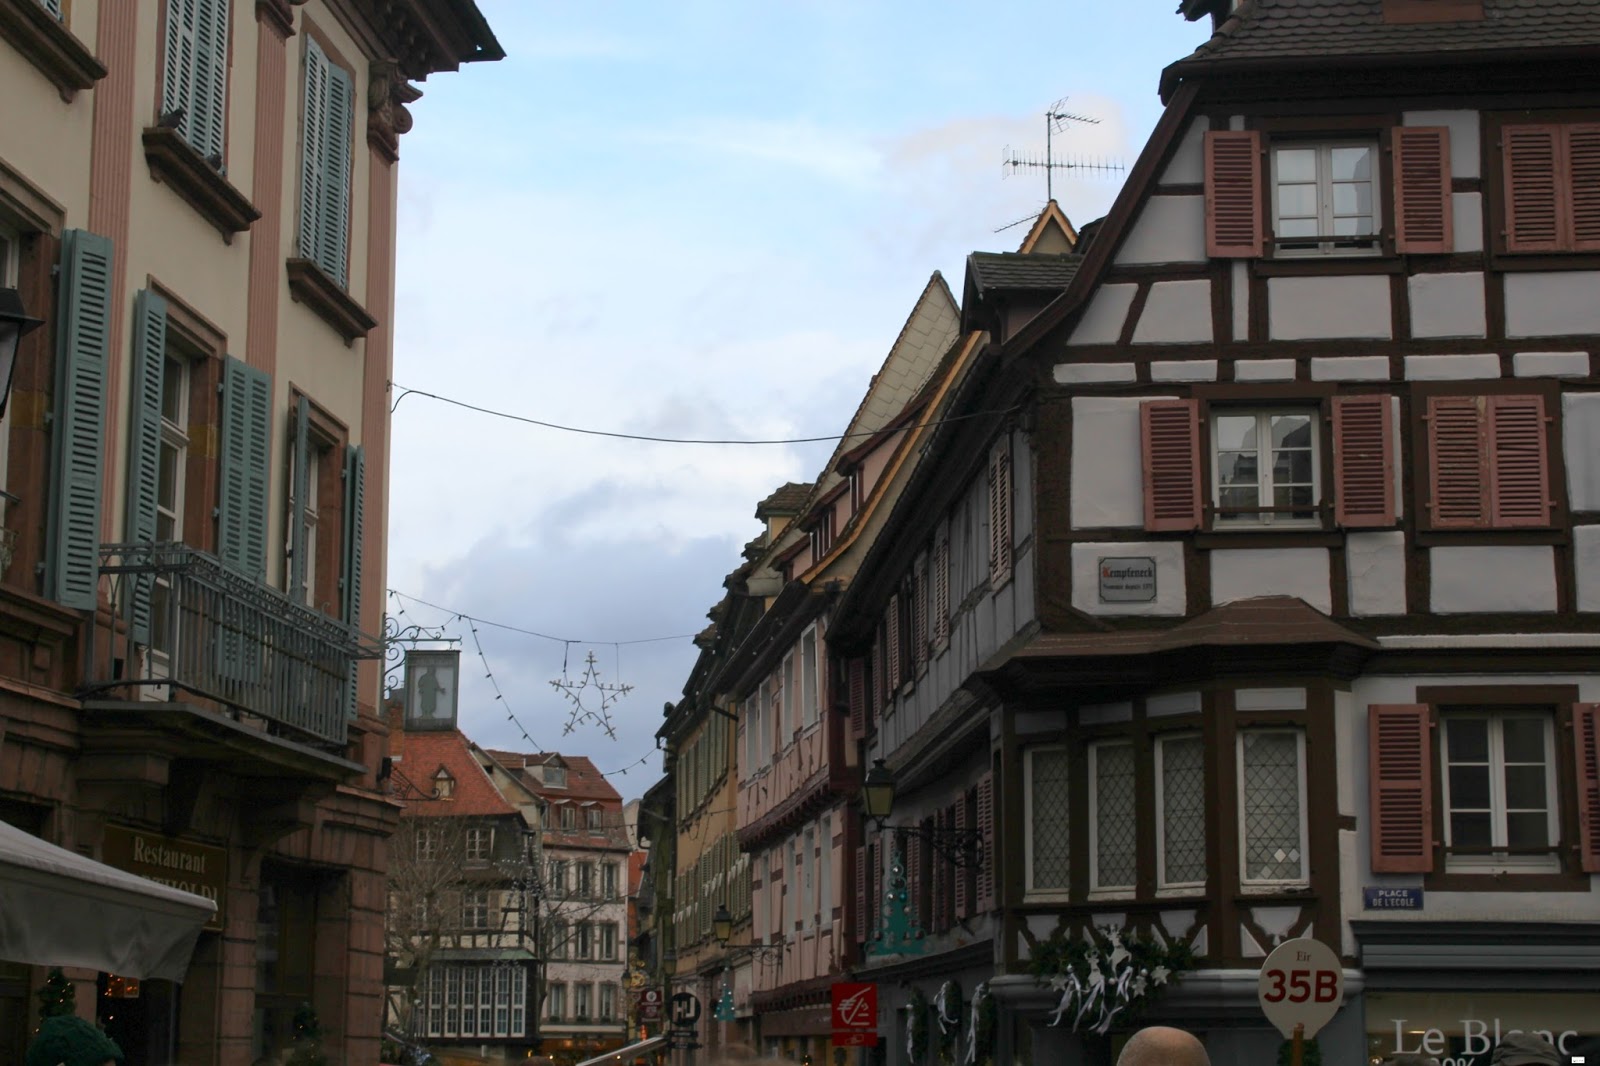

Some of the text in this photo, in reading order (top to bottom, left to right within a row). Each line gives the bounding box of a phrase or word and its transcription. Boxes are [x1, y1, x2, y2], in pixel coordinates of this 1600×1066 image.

[134, 836, 207, 874] Restaurant
[1372, 898, 1382, 907] DE
[1296, 951, 1311, 961] Eir
[1264, 969, 1337, 1003] 35B
[1390, 1019, 1445, 1055] Le
